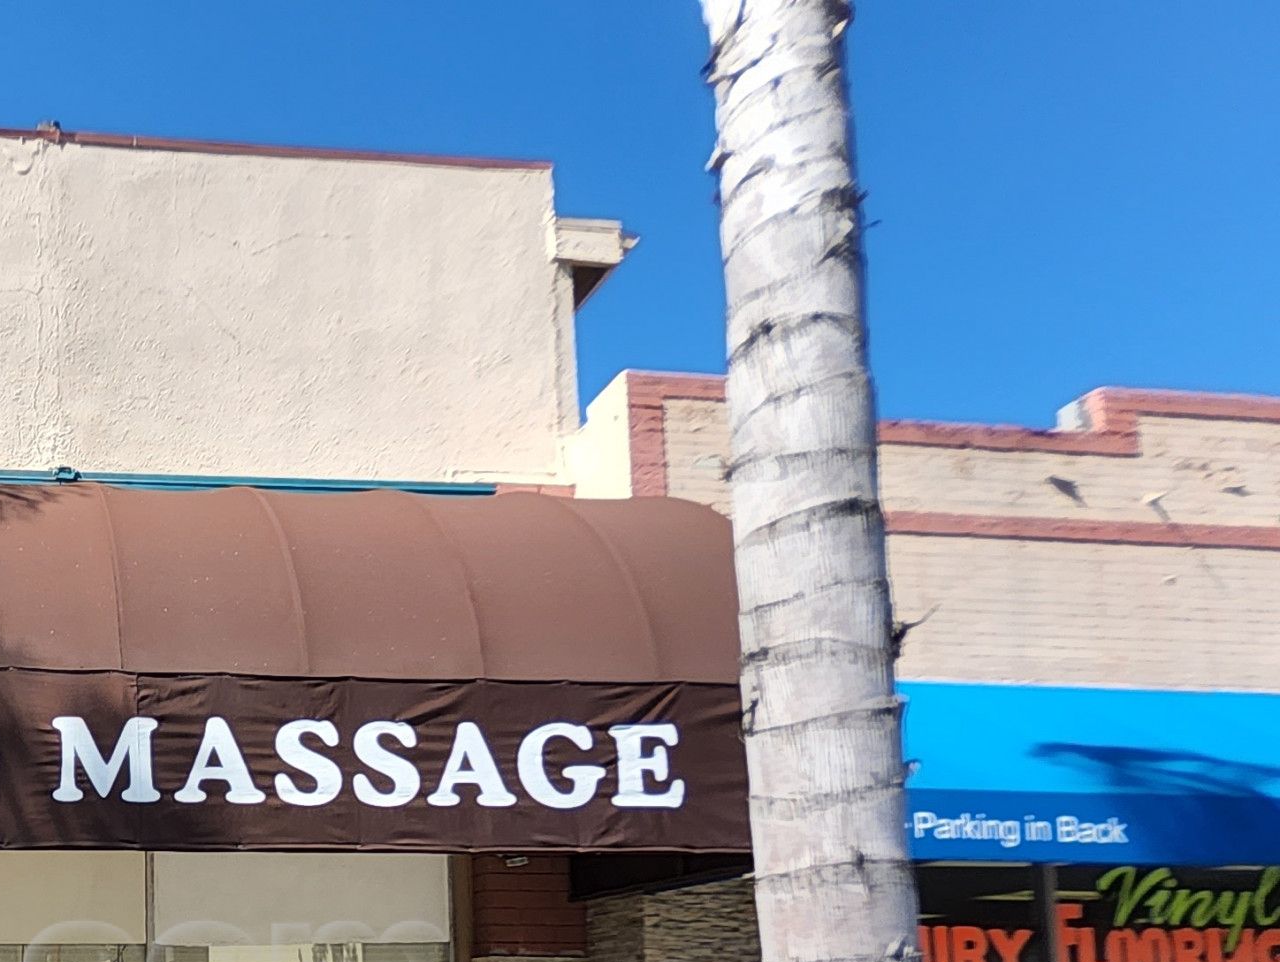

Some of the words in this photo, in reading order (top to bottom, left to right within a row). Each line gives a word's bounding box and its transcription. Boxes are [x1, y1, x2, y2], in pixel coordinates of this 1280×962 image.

[51, 715, 687, 809] MASSAGE
[913, 811, 1021, 847] Parking
[1024, 814, 1053, 841] in
[1055, 815, 1130, 844] Back
